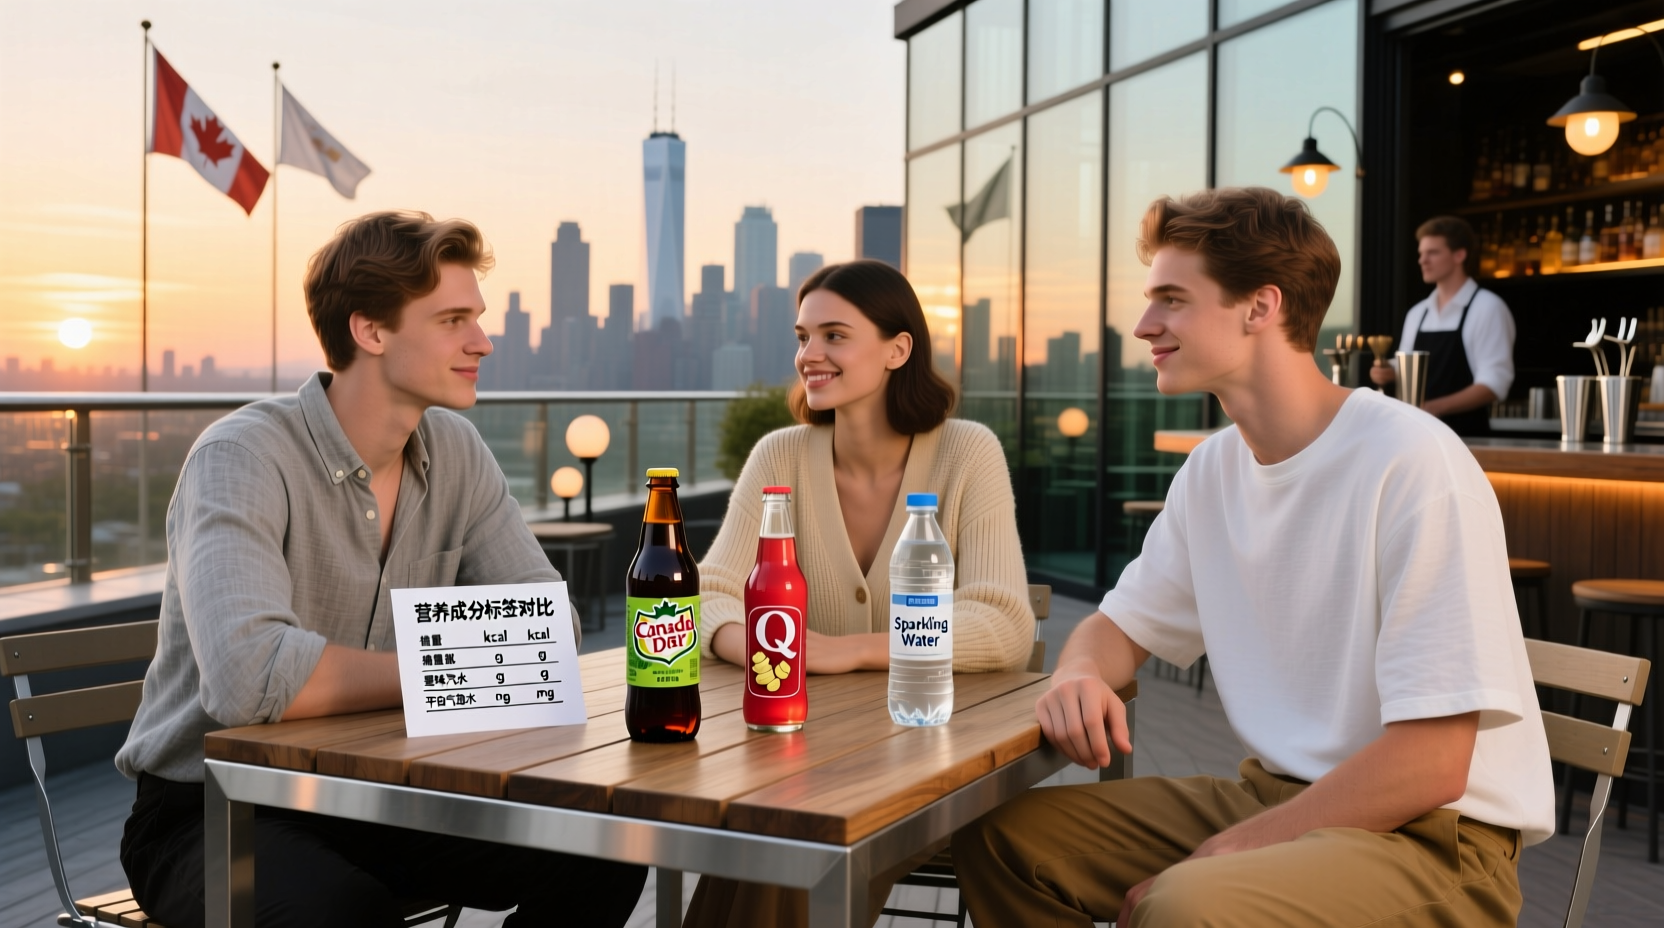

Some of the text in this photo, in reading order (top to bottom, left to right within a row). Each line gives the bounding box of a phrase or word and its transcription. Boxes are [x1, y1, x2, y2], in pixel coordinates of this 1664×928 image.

[414, 597, 555, 623] 营养成分标签对比
[894, 616, 948, 633] Sparkling
[483, 630, 508, 643] kcal
[755, 610, 797, 659] Q
[901, 633, 940, 647] Water
[496, 669, 549, 684] g g
[536, 689, 554, 702] mg
